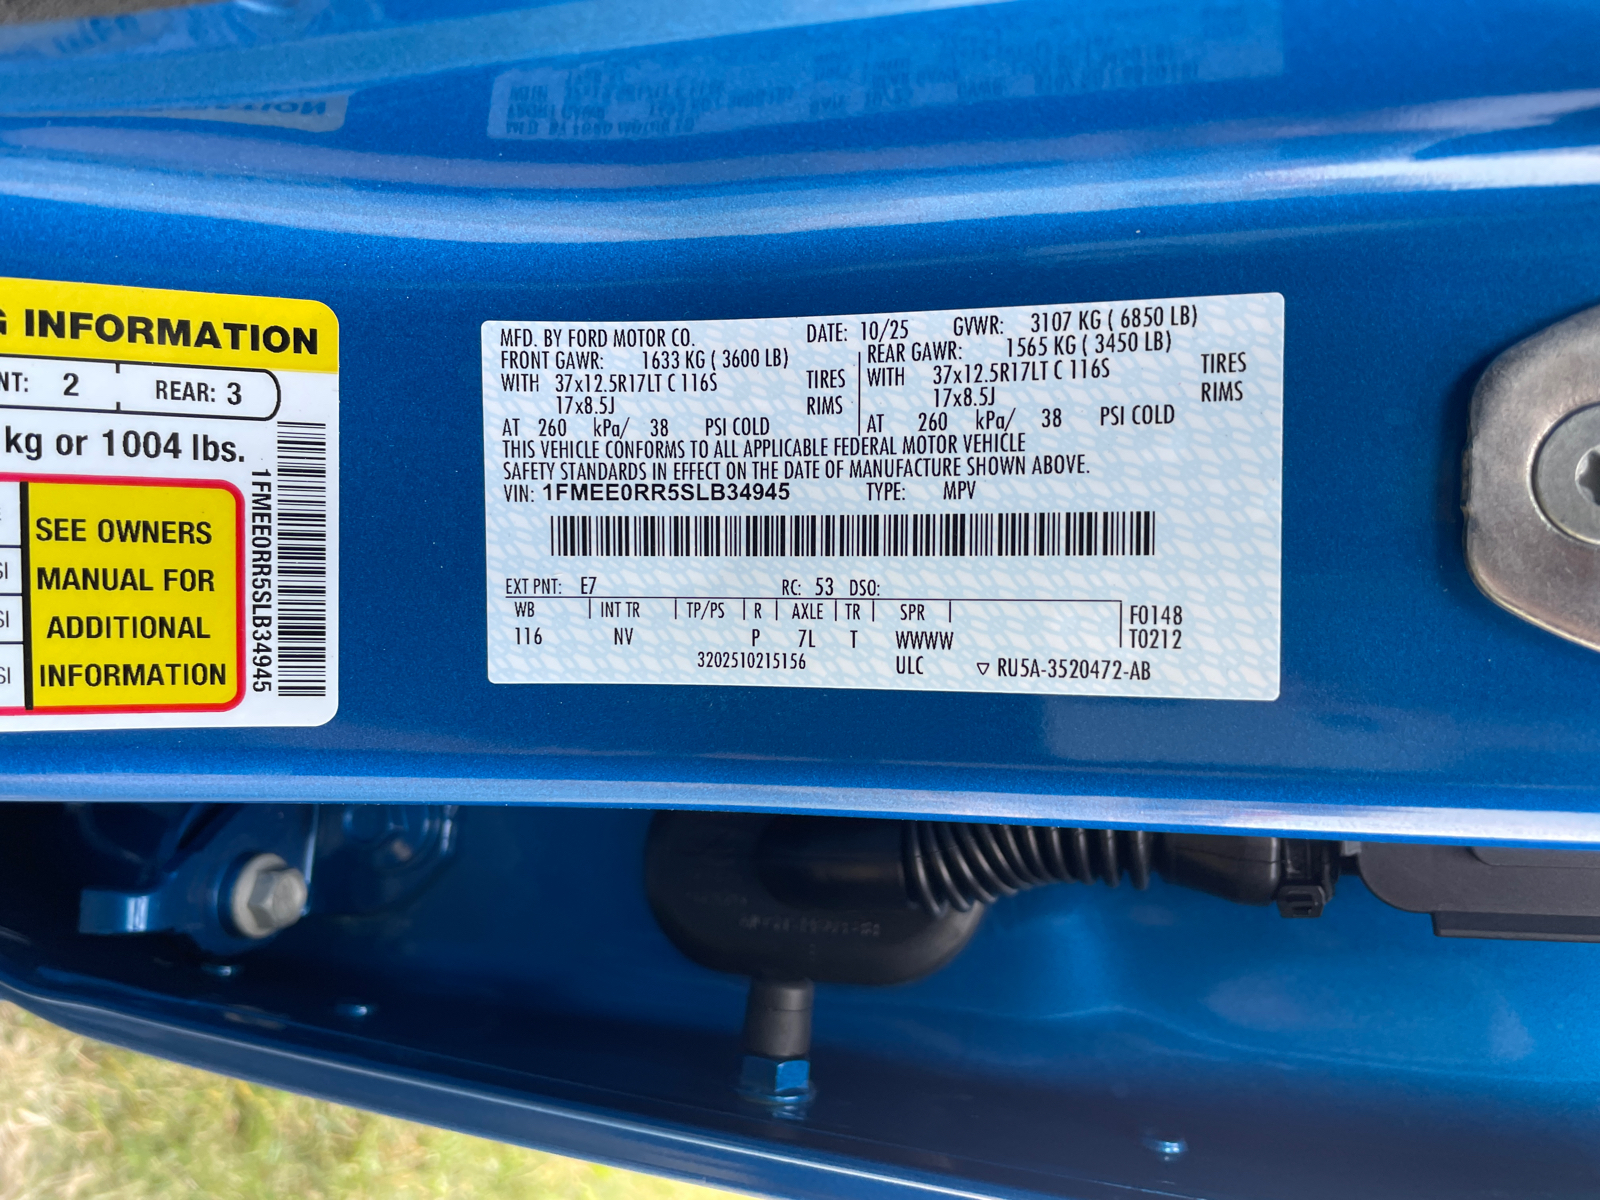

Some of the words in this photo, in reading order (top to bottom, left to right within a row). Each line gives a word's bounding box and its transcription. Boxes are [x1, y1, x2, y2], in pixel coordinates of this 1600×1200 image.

[954, 316, 1003, 336] GVWR:
[1031, 312, 1071, 332] 3107
[1079, 310, 1101, 330] KG
[1121, 307, 1163, 328] 6850
[1171, 305, 1197, 327] LB)
[25, 309, 317, 354] INFORMATION
[501, 329, 537, 347] MFD.
[545, 329, 561, 347] BY
[569, 329, 607, 347] FORD
[614, 329, 666, 347] MOTOR
[672, 328, 695, 346] CO.
[807, 323, 847, 343] DATE:
[861, 320, 908, 342] 10/25
[868, 343, 905, 363] REAR
[912, 341, 962, 361] GAWR:
[1007, 337, 1047, 357] 1565
[1055, 335, 1076, 355] KG
[1095, 332, 1138, 353] 3450
[1145, 331, 1171, 353] LB)
[502, 351, 549, 369] FRONT
[556, 351, 603, 369] GAWR:
[643, 351, 679, 369] 1633
[686, 350, 705, 369] KG
[723, 349, 759, 368] 3600
[766, 348, 788, 369] LB)
[867, 367, 904, 387] WITH
[933, 361, 1048, 384] 37x12.5R17LT
[1054, 360, 1062, 379] C
[1071, 358, 1109, 379] 116S
[1201, 352, 1246, 373] TIRES
[64, 373, 79, 396] 2
[501, 374, 539, 392] WITH
[556, 374, 662, 392] 37x12.5R17LT
[668, 373, 675, 392] C
[682, 372, 717, 392] 116S
[806, 369, 845, 389] TIRES
[156, 380, 215, 402] REAR:
[227, 382, 241, 405] 3
[934, 387, 994, 407] 17x8.5J
[1202, 381, 1243, 402] RIMS
[557, 396, 614, 414] 17x8.5J
[807, 395, 842, 415] RIMS
[502, 418, 520, 436] AT
[538, 418, 566, 436] 260
[594, 417, 630, 439] kPa/
[651, 418, 668, 436] 38
[706, 417, 726, 436] PSI
[733, 417, 769, 435] COLD
[867, 414, 884, 433] AT
[918, 412, 947, 431] 260
[976, 408, 1016, 431] kPa/
[1042, 408, 1061, 427] 38
[1101, 406, 1124, 426] PSI
[1132, 404, 1174, 424] COLD
[6, 426, 42, 460] kg
[56, 434, 88, 455] or
[102, 429, 182, 459] 1004
[193, 434, 244, 462] lbs.
[502, 440, 535, 458] THIS
[541, 440, 599, 458] VEHICLE
[606, 440, 685, 458] CONFORMS
[690, 440, 708, 458] TO
[714, 440, 738, 458] ALL
[744, 438, 828, 457] APPLICABLE
[835, 437, 897, 456] FEDERAL
[903, 435, 957, 454] MOTOR
[963, 433, 1025, 453] VEHICLE
[504, 462, 555, 480] SAFETY
[561, 462, 646, 480] STANDARDS
[653, 463, 666, 480] IN
[674, 462, 720, 480] EFFECT
[727, 462, 746, 479] ON
[752, 461, 778, 479] THE
[785, 461, 819, 479] DATE
[826, 460, 843, 478] OF
[850, 458, 960, 478] MANUFACTURE
[967, 456, 1025, 476] SHOWN
[1032, 454, 1089, 474] ABOVE.
[504, 484, 534, 502] VIN:
[543, 483, 790, 500] 1FMEE0RR5SLB34945
[866, 482, 905, 501] TYPE:
[943, 481, 976, 500] MPV
[36, 518, 86, 541] SEE
[98, 519, 212, 544] OWNERS
[38, 568, 153, 591] MANUAL
[164, 569, 214, 592] FOR
[252, 469, 272, 692] 1FMEE0RR5SLB34945
[506, 578, 529, 594] EXT
[534, 578, 561, 594] PNT:
[581, 577, 597, 594] E7
[782, 579, 801, 595] RC:
[815, 577, 833, 596] 53
[850, 580, 880, 596] DSO:
[515, 602, 534, 617] WB
[601, 602, 621, 617] INT
[626, 602, 640, 617] TR
[687, 600, 724, 620] TP/PS
[755, 603, 761, 619] R
[792, 603, 823, 619] AXLE
[845, 604, 860, 620] TR
[901, 604, 925, 620] SPR
[1131, 605, 1182, 625] F0148
[47, 616, 210, 639] ADDITIONAL
[515, 627, 542, 645] 116
[614, 628, 633, 645] NV
[752, 629, 760, 646] P
[799, 629, 815, 647] 7L
[850, 630, 858, 648] T
[895, 631, 954, 650] WWWW
[1129, 629, 1181, 649] T0212
[698, 651, 806, 669] 3202510215156
[896, 656, 923, 674] ULC
[998, 658, 1150, 680] RU5A-3520472-AB
[41, 663, 225, 686] INFORMATION
